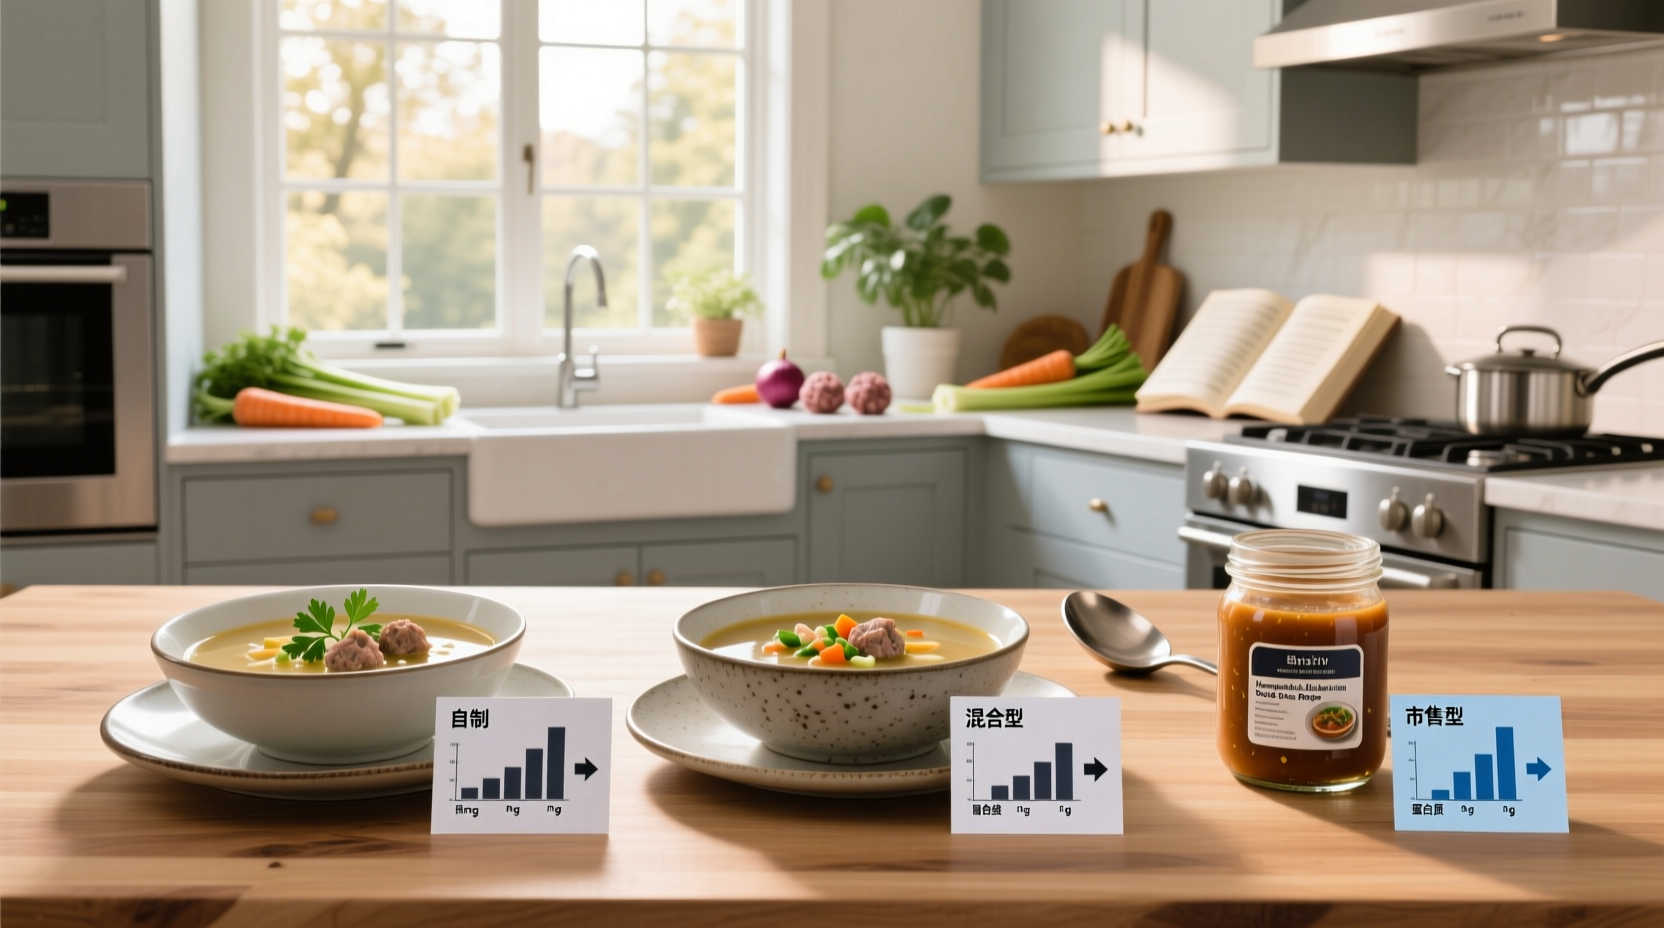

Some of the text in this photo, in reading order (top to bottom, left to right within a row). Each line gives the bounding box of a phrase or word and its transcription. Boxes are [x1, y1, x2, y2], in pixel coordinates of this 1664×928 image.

[451, 708, 490, 729] 自制
[965, 707, 1024, 729] 混合型
[1405, 705, 1464, 727] 市售型
